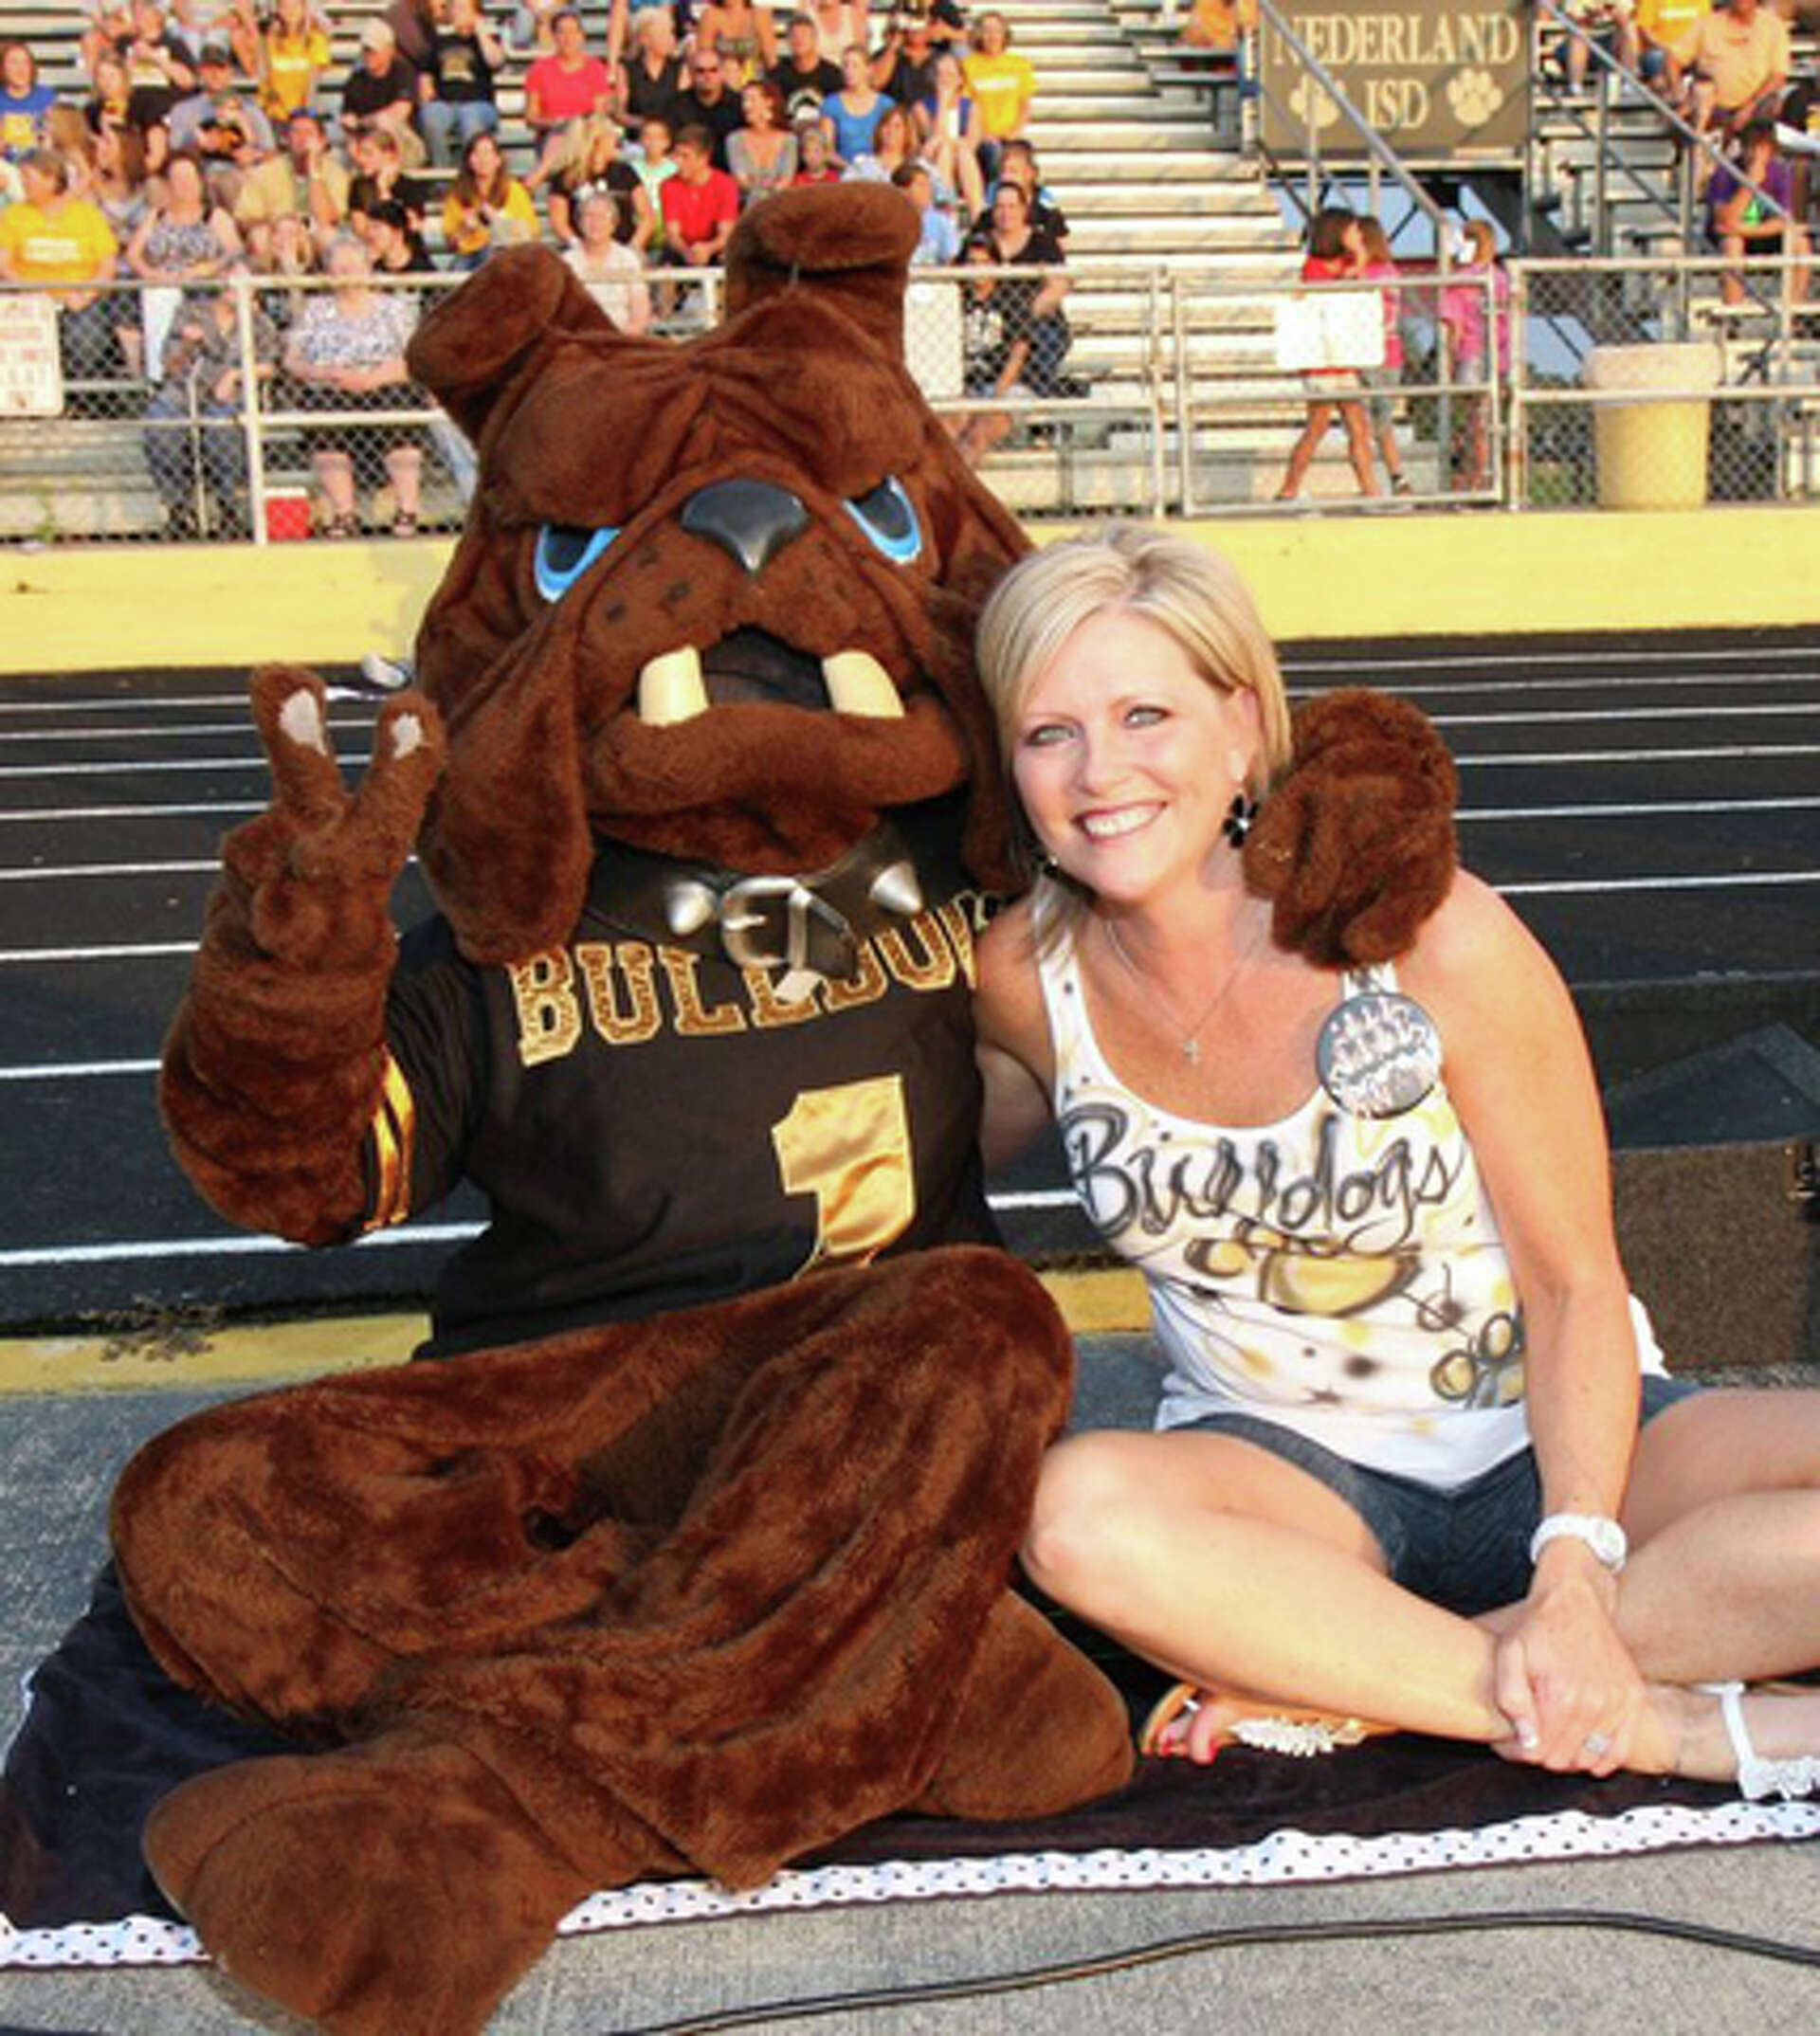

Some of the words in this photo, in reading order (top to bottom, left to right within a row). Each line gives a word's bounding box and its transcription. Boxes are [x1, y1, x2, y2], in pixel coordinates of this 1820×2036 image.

[1273, 14, 1519, 65] NEDERLAND
[1365, 79, 1429, 130] ISD
[771, 1073, 917, 1280] 1
[1060, 1101, 1465, 1254] Bulldogs
